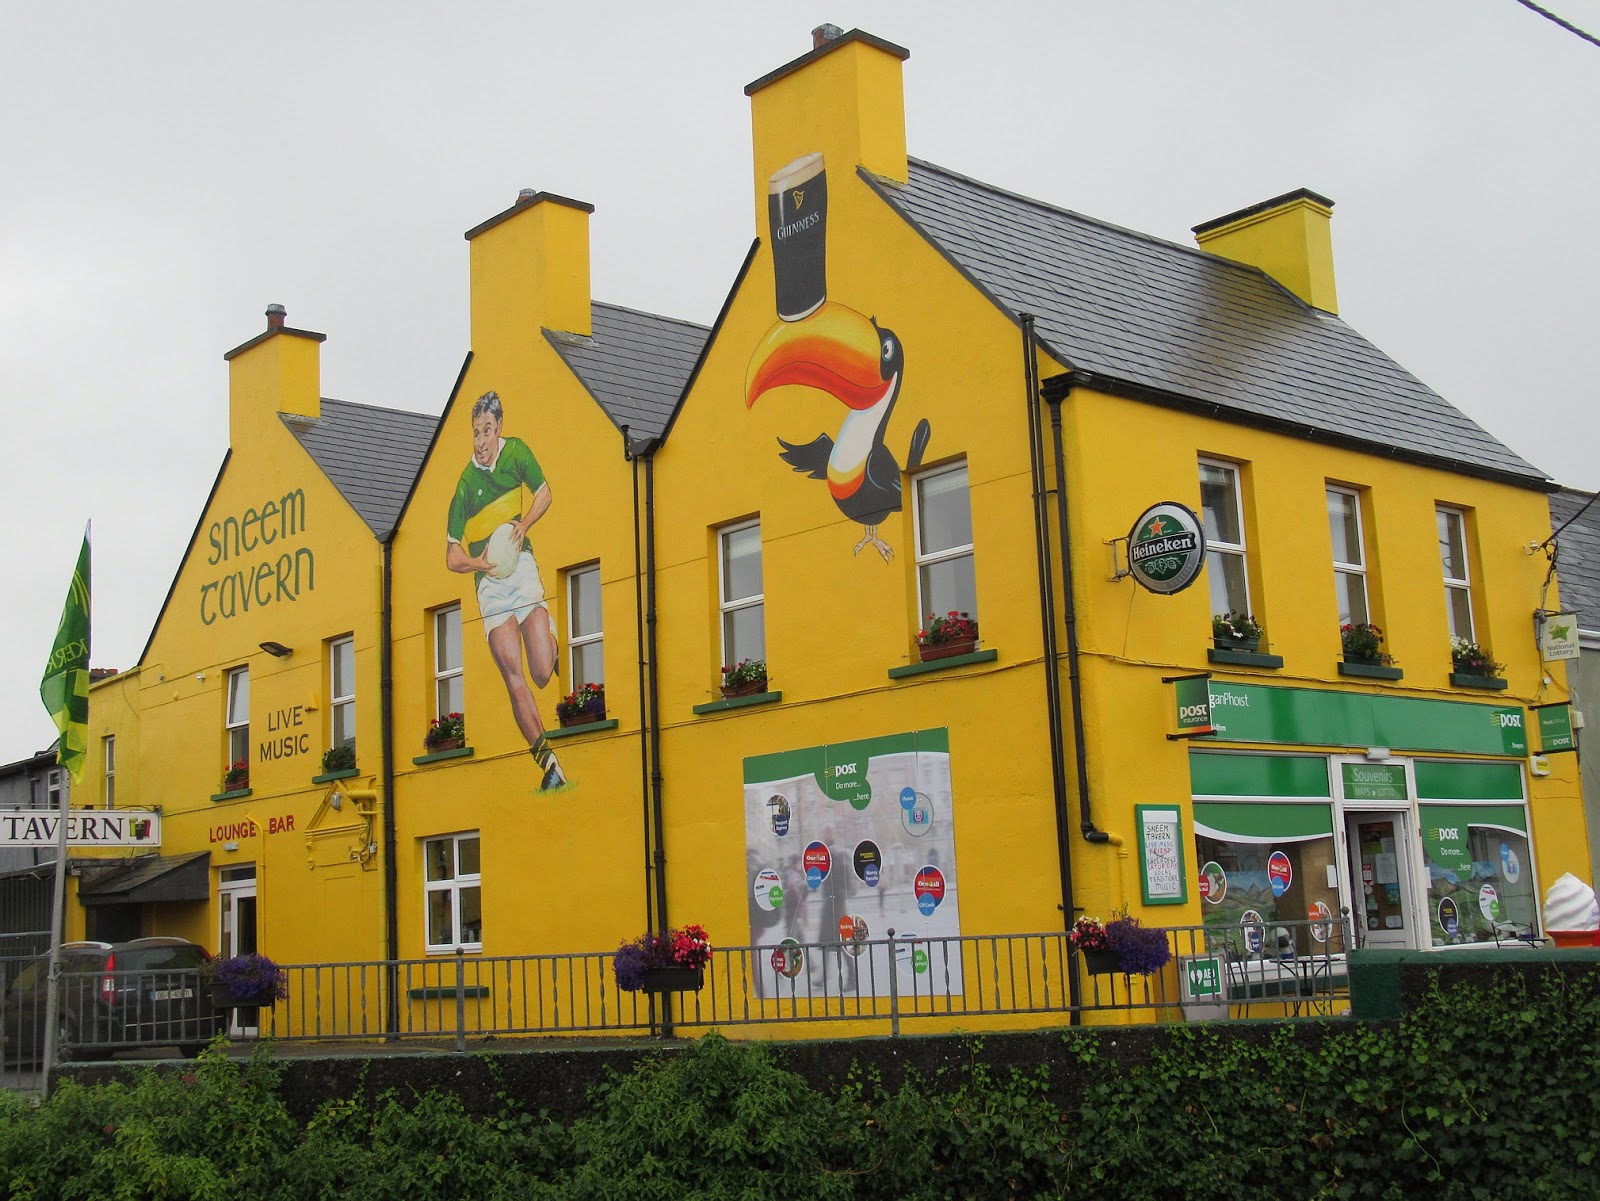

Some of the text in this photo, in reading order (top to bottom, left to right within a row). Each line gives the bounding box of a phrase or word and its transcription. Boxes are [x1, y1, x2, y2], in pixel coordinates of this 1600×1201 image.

[777, 211, 820, 241] GUINNESS
[1133, 538, 1192, 561] Heineken
[1546, 642, 1575, 651] National
[1549, 649, 1574, 657] Lottery
[268, 705, 303, 732] LIVE
[1180, 704, 1207, 719] post
[1500, 713, 1521, 728] post
[260, 734, 309, 763] MUSIC
[1552, 737, 1570, 746] post
[835, 763, 857, 777] post
[1353, 768, 1393, 783] Souvenirs
[835, 782, 844, 790] Do
[1354, 786, 1395, 797] MAPS LOTTO
[3, 816, 124, 841] TAVERN
[209, 815, 296, 843] LOUNGE BAR
[1146, 824, 1169, 833] SNEEM
[1439, 828, 1459, 841] post
[1155, 883, 1176, 891] MUSIC
